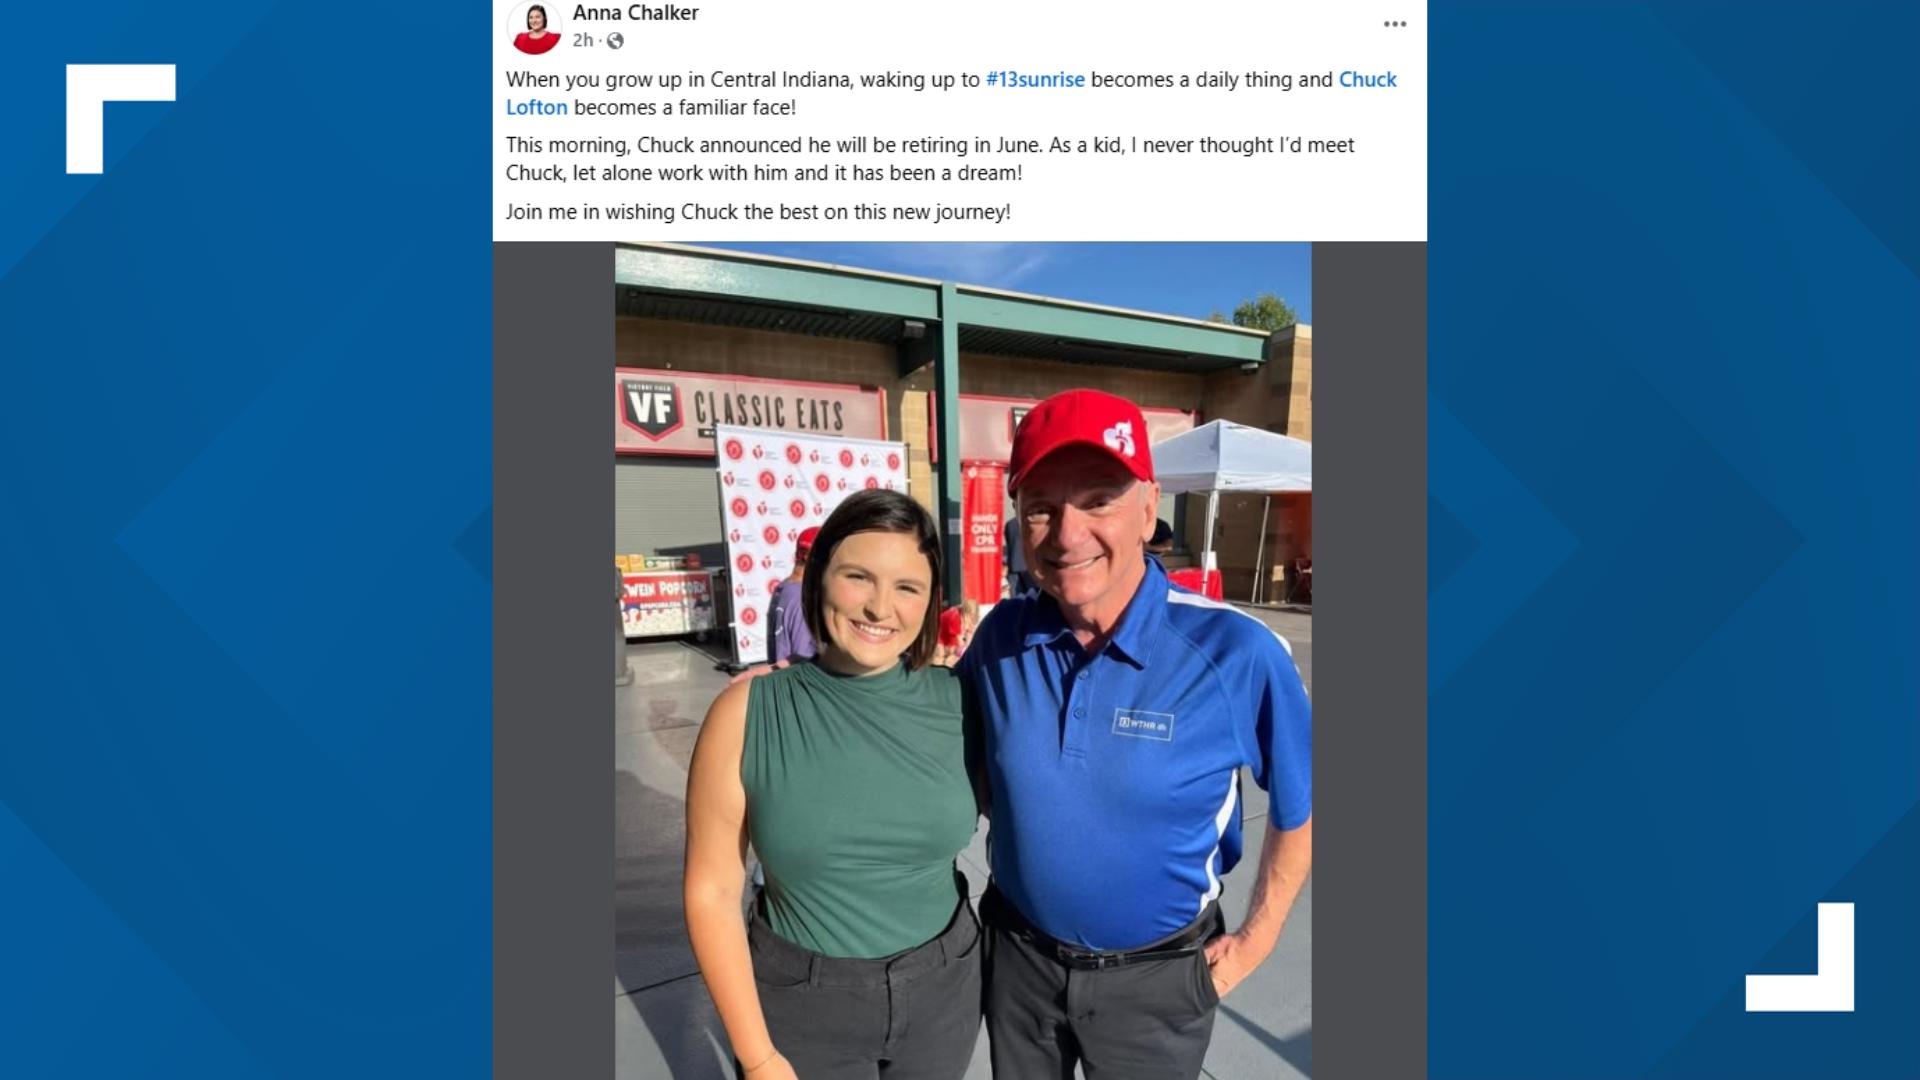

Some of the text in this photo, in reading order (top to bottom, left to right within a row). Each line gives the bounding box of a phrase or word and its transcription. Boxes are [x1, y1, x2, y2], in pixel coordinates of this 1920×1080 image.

[628, 391, 672, 424] VF
[694, 390, 843, 431] CLASSIC EATS
[970, 524, 998, 535] ONLY
